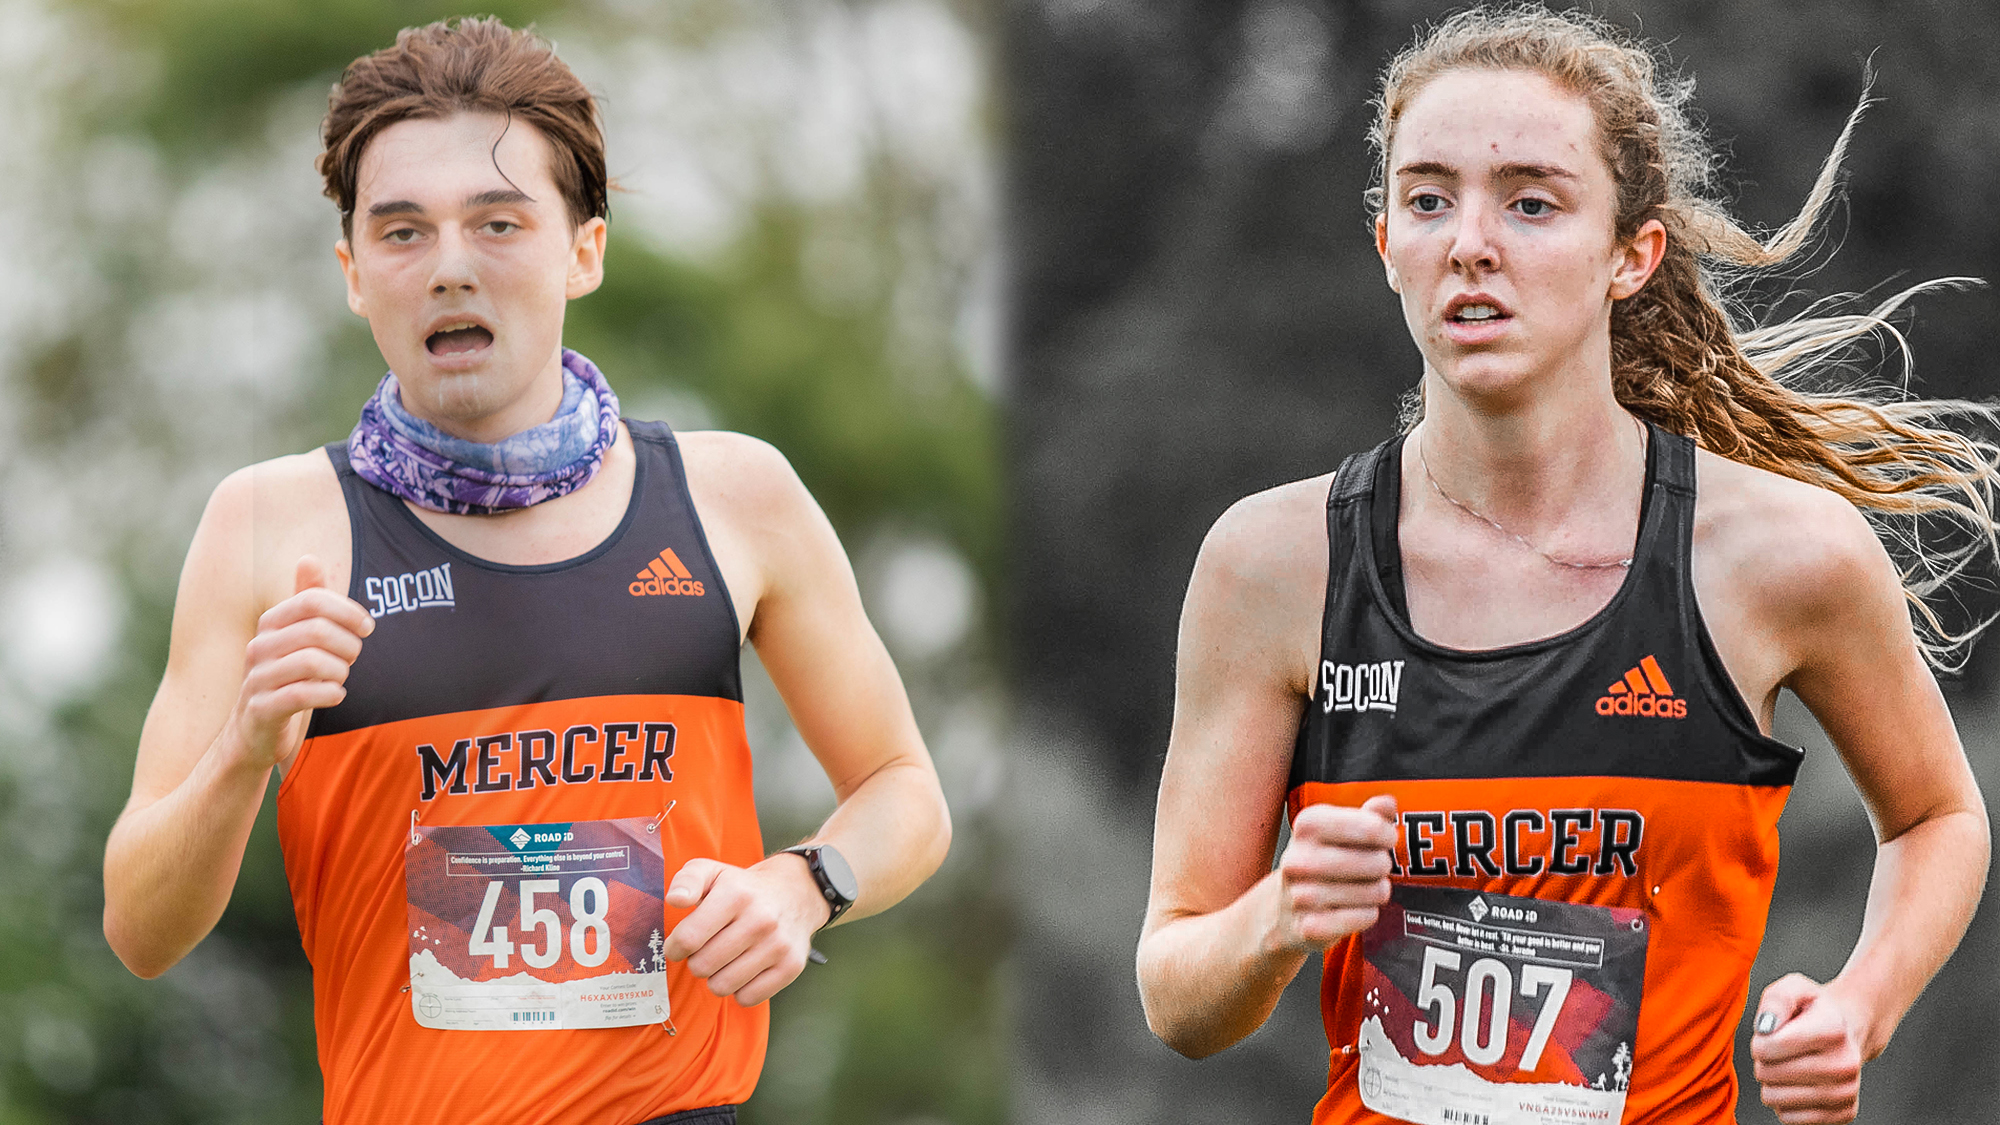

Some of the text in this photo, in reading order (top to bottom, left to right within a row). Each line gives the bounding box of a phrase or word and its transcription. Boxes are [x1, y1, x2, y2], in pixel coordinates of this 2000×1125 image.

[628, 576, 705, 597] adidas
[1595, 692, 1687, 719] adidas
[416, 722, 677, 801] MERCER
[534, 832, 561, 843] ROAD
[451, 850, 625, 865] Confidence is preparation. Everything else is beyond your control.
[469, 876, 611, 969] 458
[1492, 905, 1524, 921] ROAD
[1527, 935, 1544, 947] good
[1572, 941, 1585, 952] and
[1413, 945, 1573, 1073] 507
